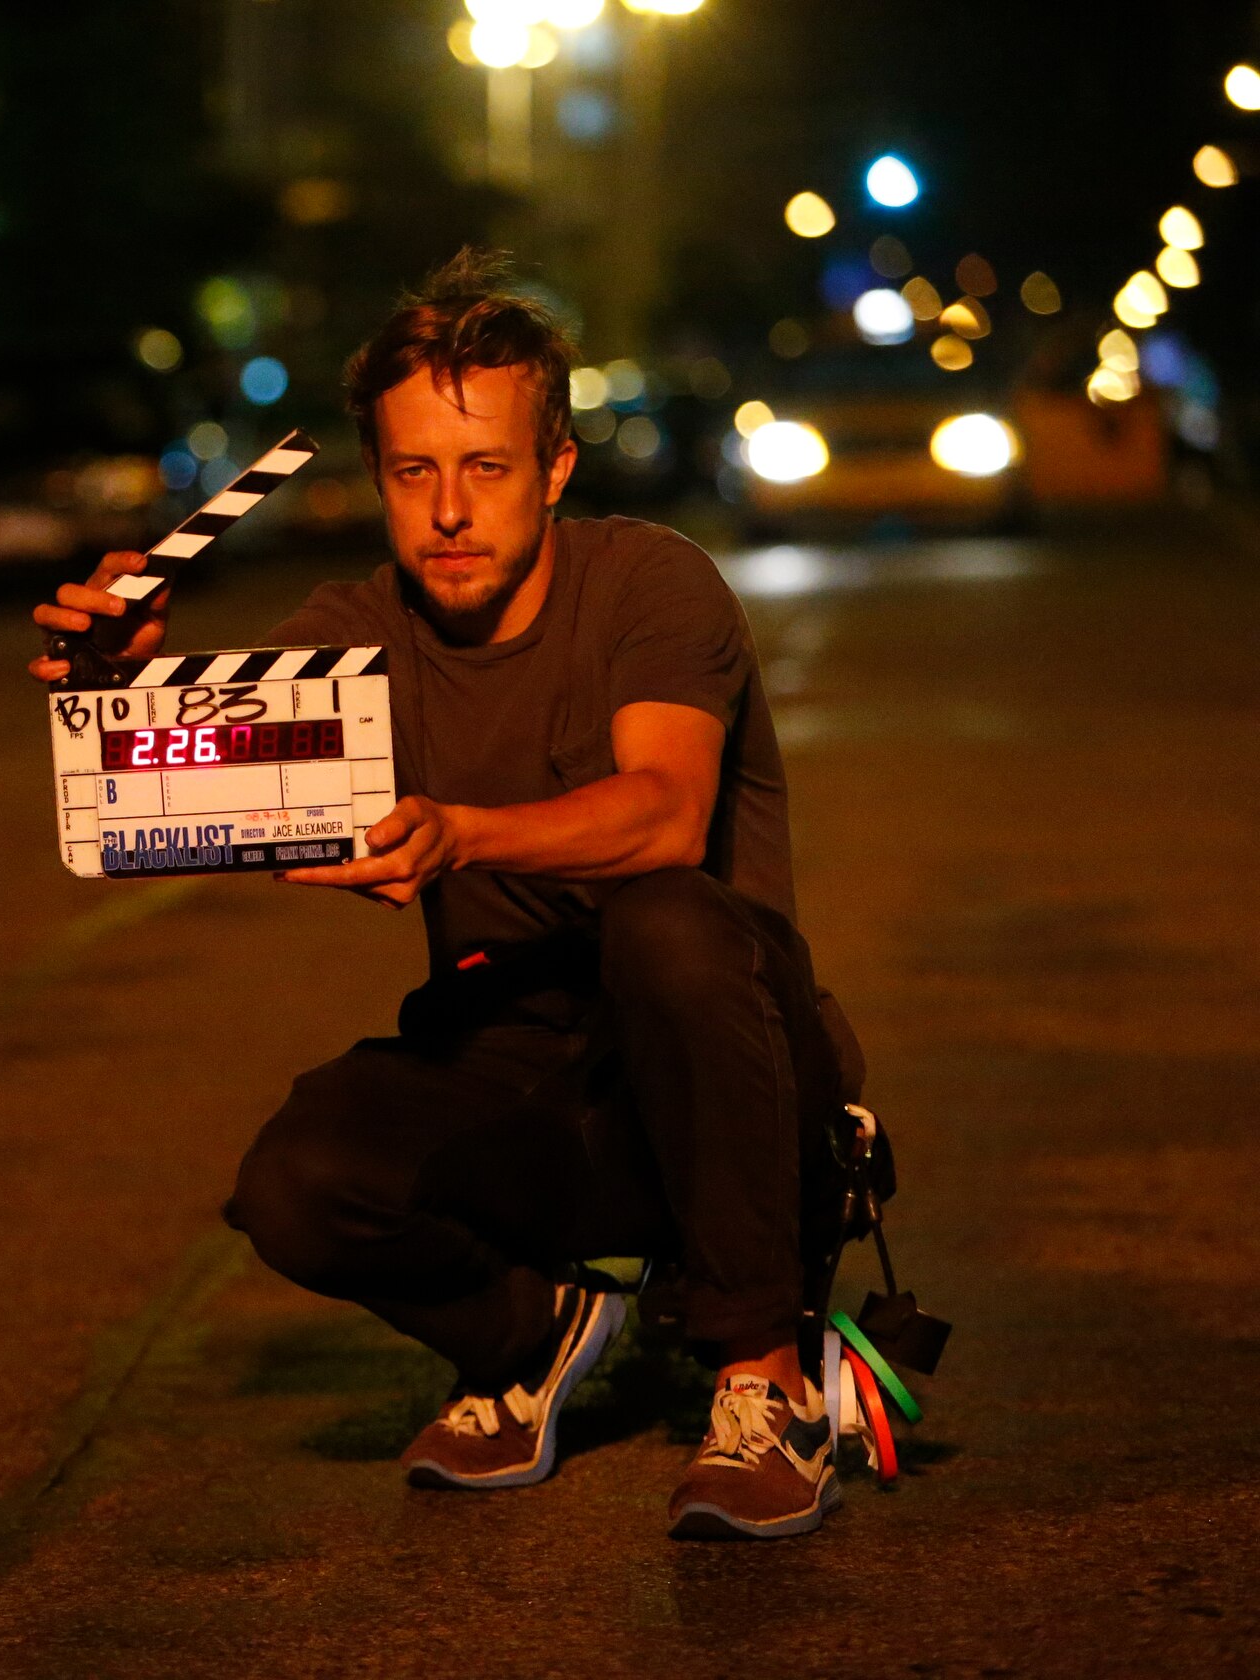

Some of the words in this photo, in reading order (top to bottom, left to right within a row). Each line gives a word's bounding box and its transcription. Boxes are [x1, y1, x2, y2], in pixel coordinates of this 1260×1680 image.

[175, 684, 268, 726] 83
[62, 778, 70, 804] PROD
[105, 778, 118, 805] B
[306, 808, 325, 817] EPISODE
[240, 828, 266, 839] DIRECTOR
[272, 824, 293, 838] JACE
[295, 821, 344, 837] ALEXANDER
[102, 824, 235, 871] BLACKLIST
